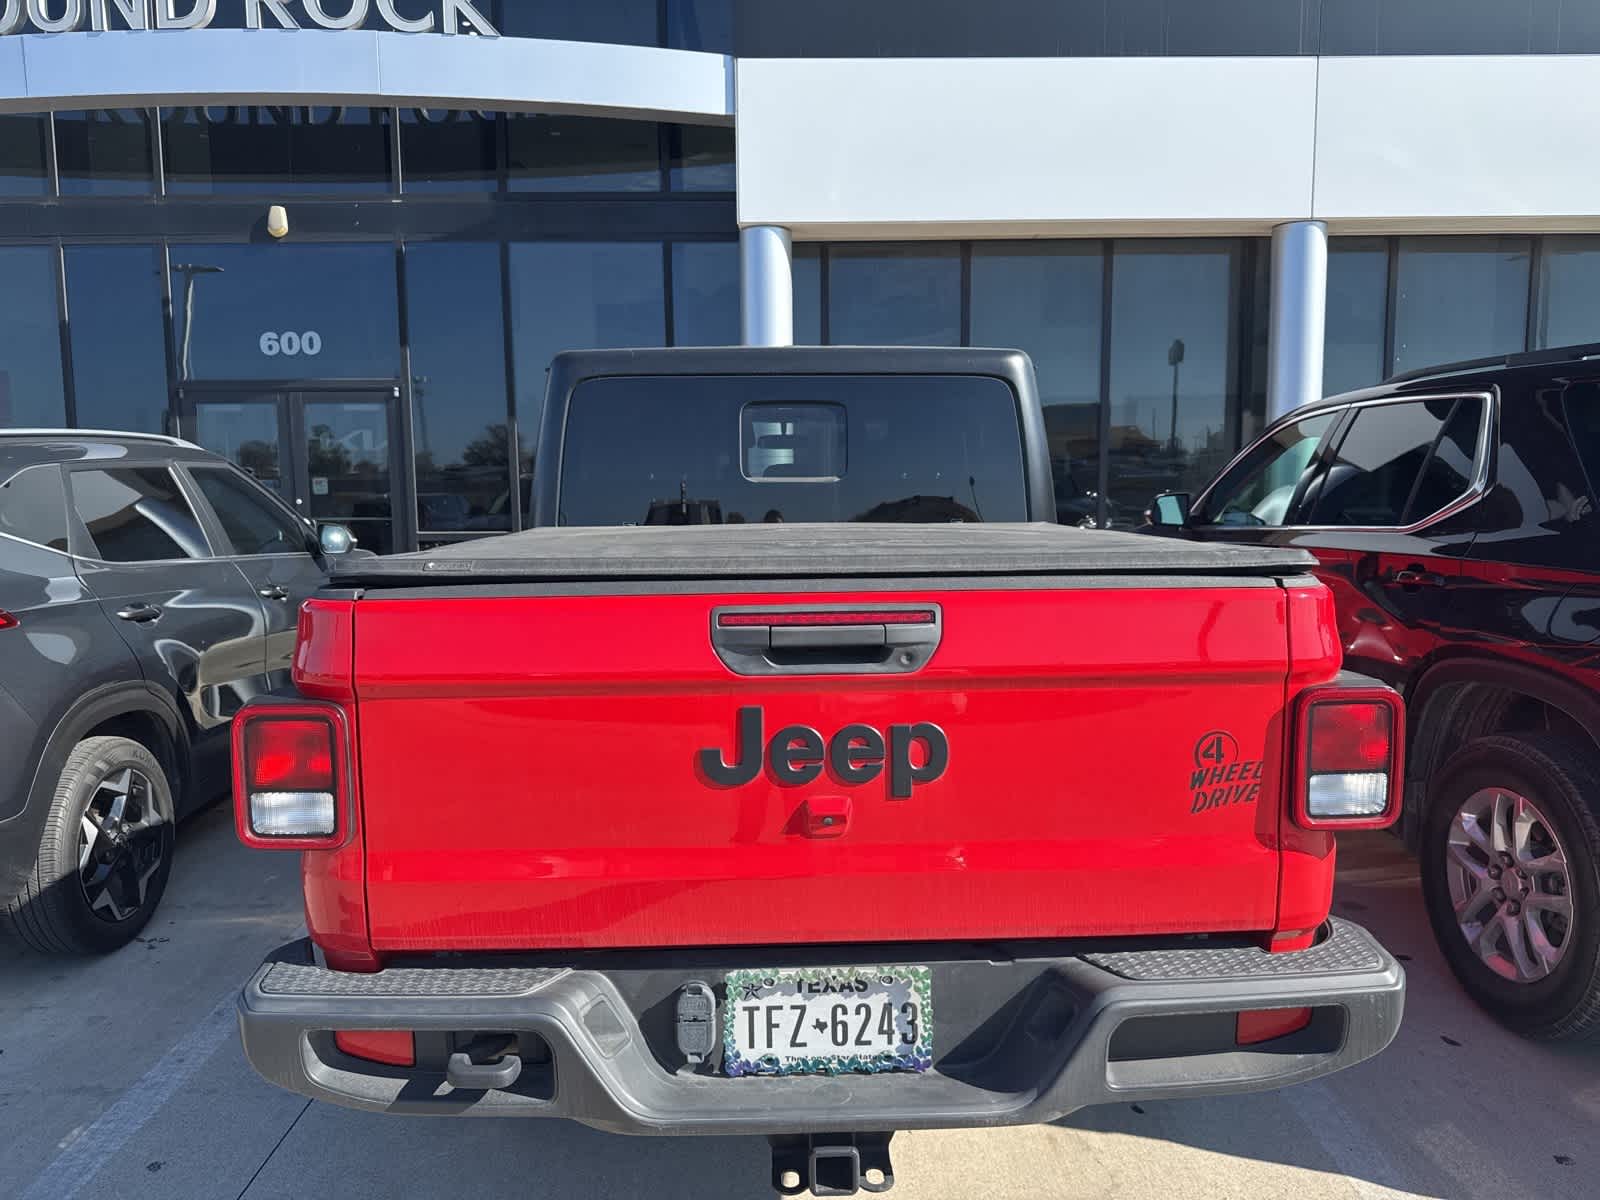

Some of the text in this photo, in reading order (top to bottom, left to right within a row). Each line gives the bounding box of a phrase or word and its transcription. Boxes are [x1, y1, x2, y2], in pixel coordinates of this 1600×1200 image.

[259, 331, 322, 356] 600
[698, 705, 949, 800] Jeep
[1202, 736, 1225, 764] 4
[1190, 761, 1264, 790] WHEEL
[1191, 783, 1262, 814] DRIVE
[796, 976, 868, 993] TEXAS
[742, 1004, 808, 1049] TFZ
[830, 1002, 918, 1047] 6243
